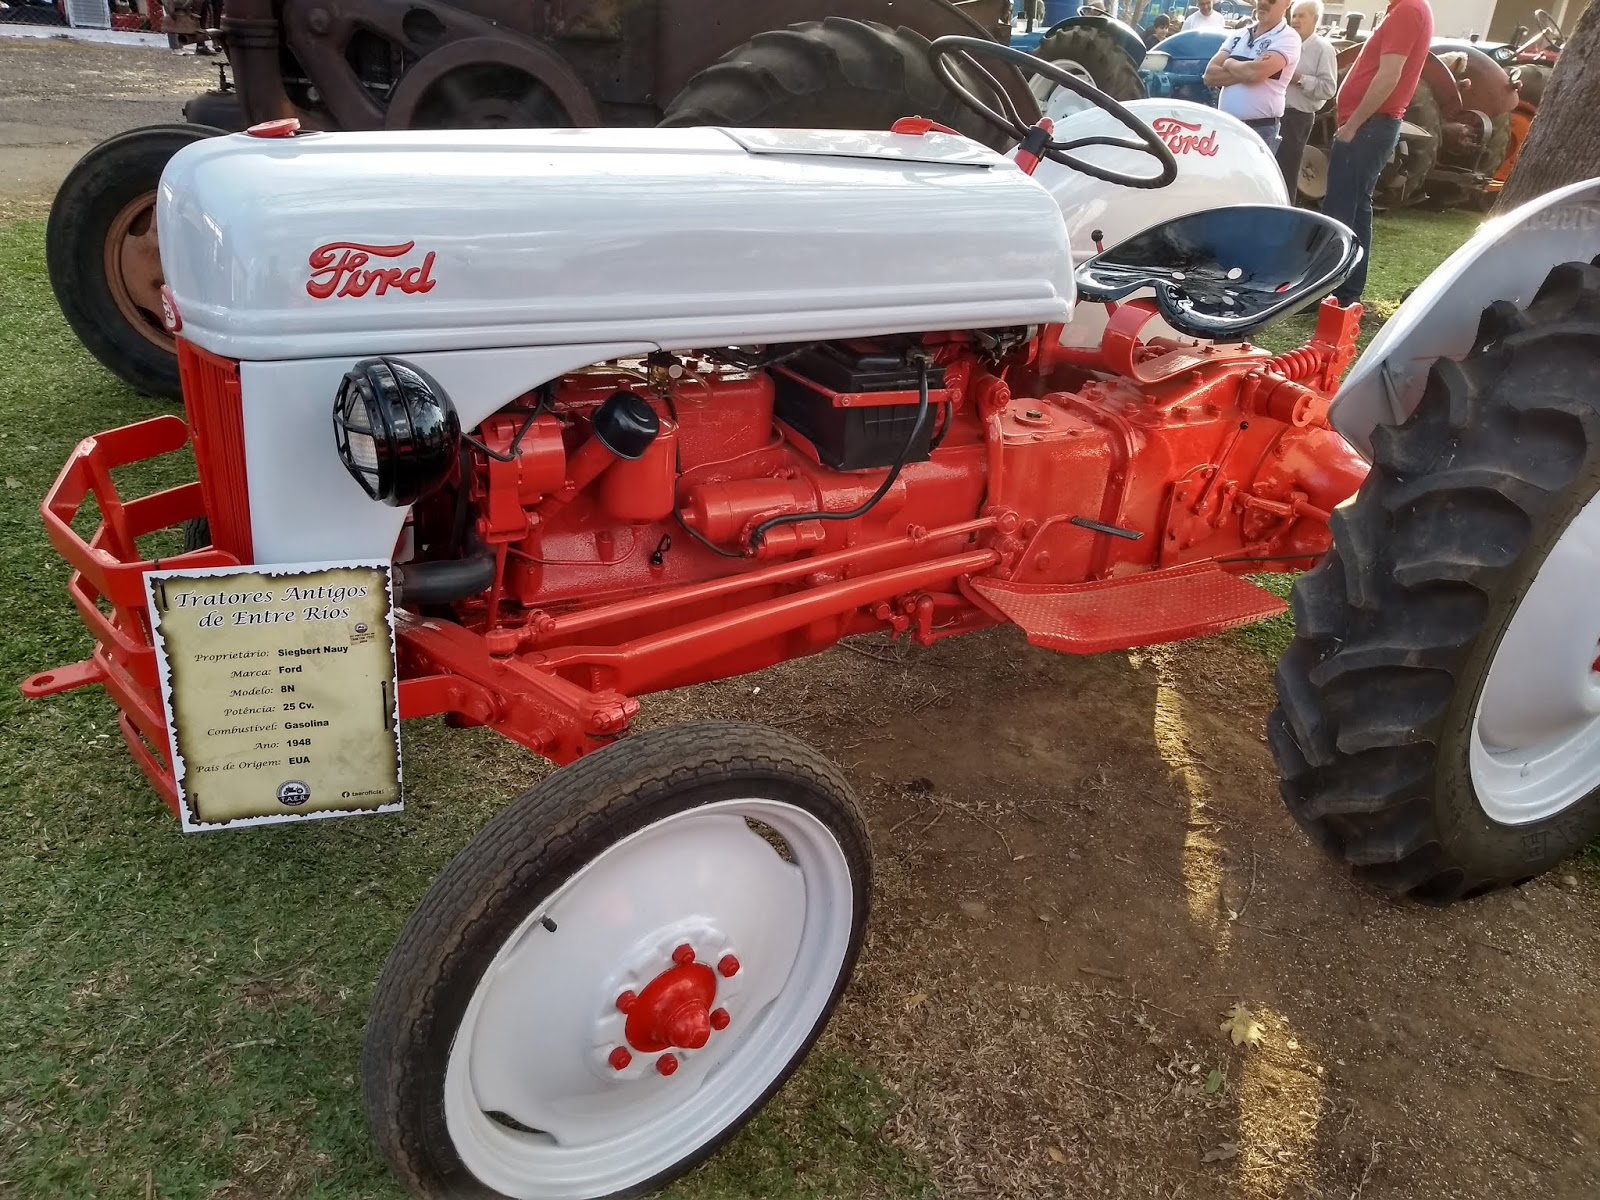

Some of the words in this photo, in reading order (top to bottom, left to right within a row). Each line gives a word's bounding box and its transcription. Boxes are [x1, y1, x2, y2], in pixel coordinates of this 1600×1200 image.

[1152, 117, 1219, 156] Ford
[306, 240, 437, 299] Ford
[174, 590, 273, 608] Tratores
[281, 583, 368, 602] Antigos
[199, 610, 225, 627] de
[232, 609, 296, 625] Entre
[194, 649, 270, 664] Proprietário:
[278, 646, 322, 658] Siegbert
[323, 644, 349, 656] Nauy
[230, 668, 272, 679] Marca:
[279, 665, 303, 674] Ford
[230, 686, 274, 698] Modelo:
[280, 684, 295, 693] 8N
[223, 704, 276, 717] Potência:
[283, 702, 296, 711] 25
[298, 701, 315, 710] Cv.
[284, 719, 330, 730] Gasolina
[252, 740, 280, 750] Ano:
[286, 738, 311, 748] 1948
[222, 762, 236, 772] de
[238, 758, 282, 771] Origem:
[289, 756, 311, 766] EUA
